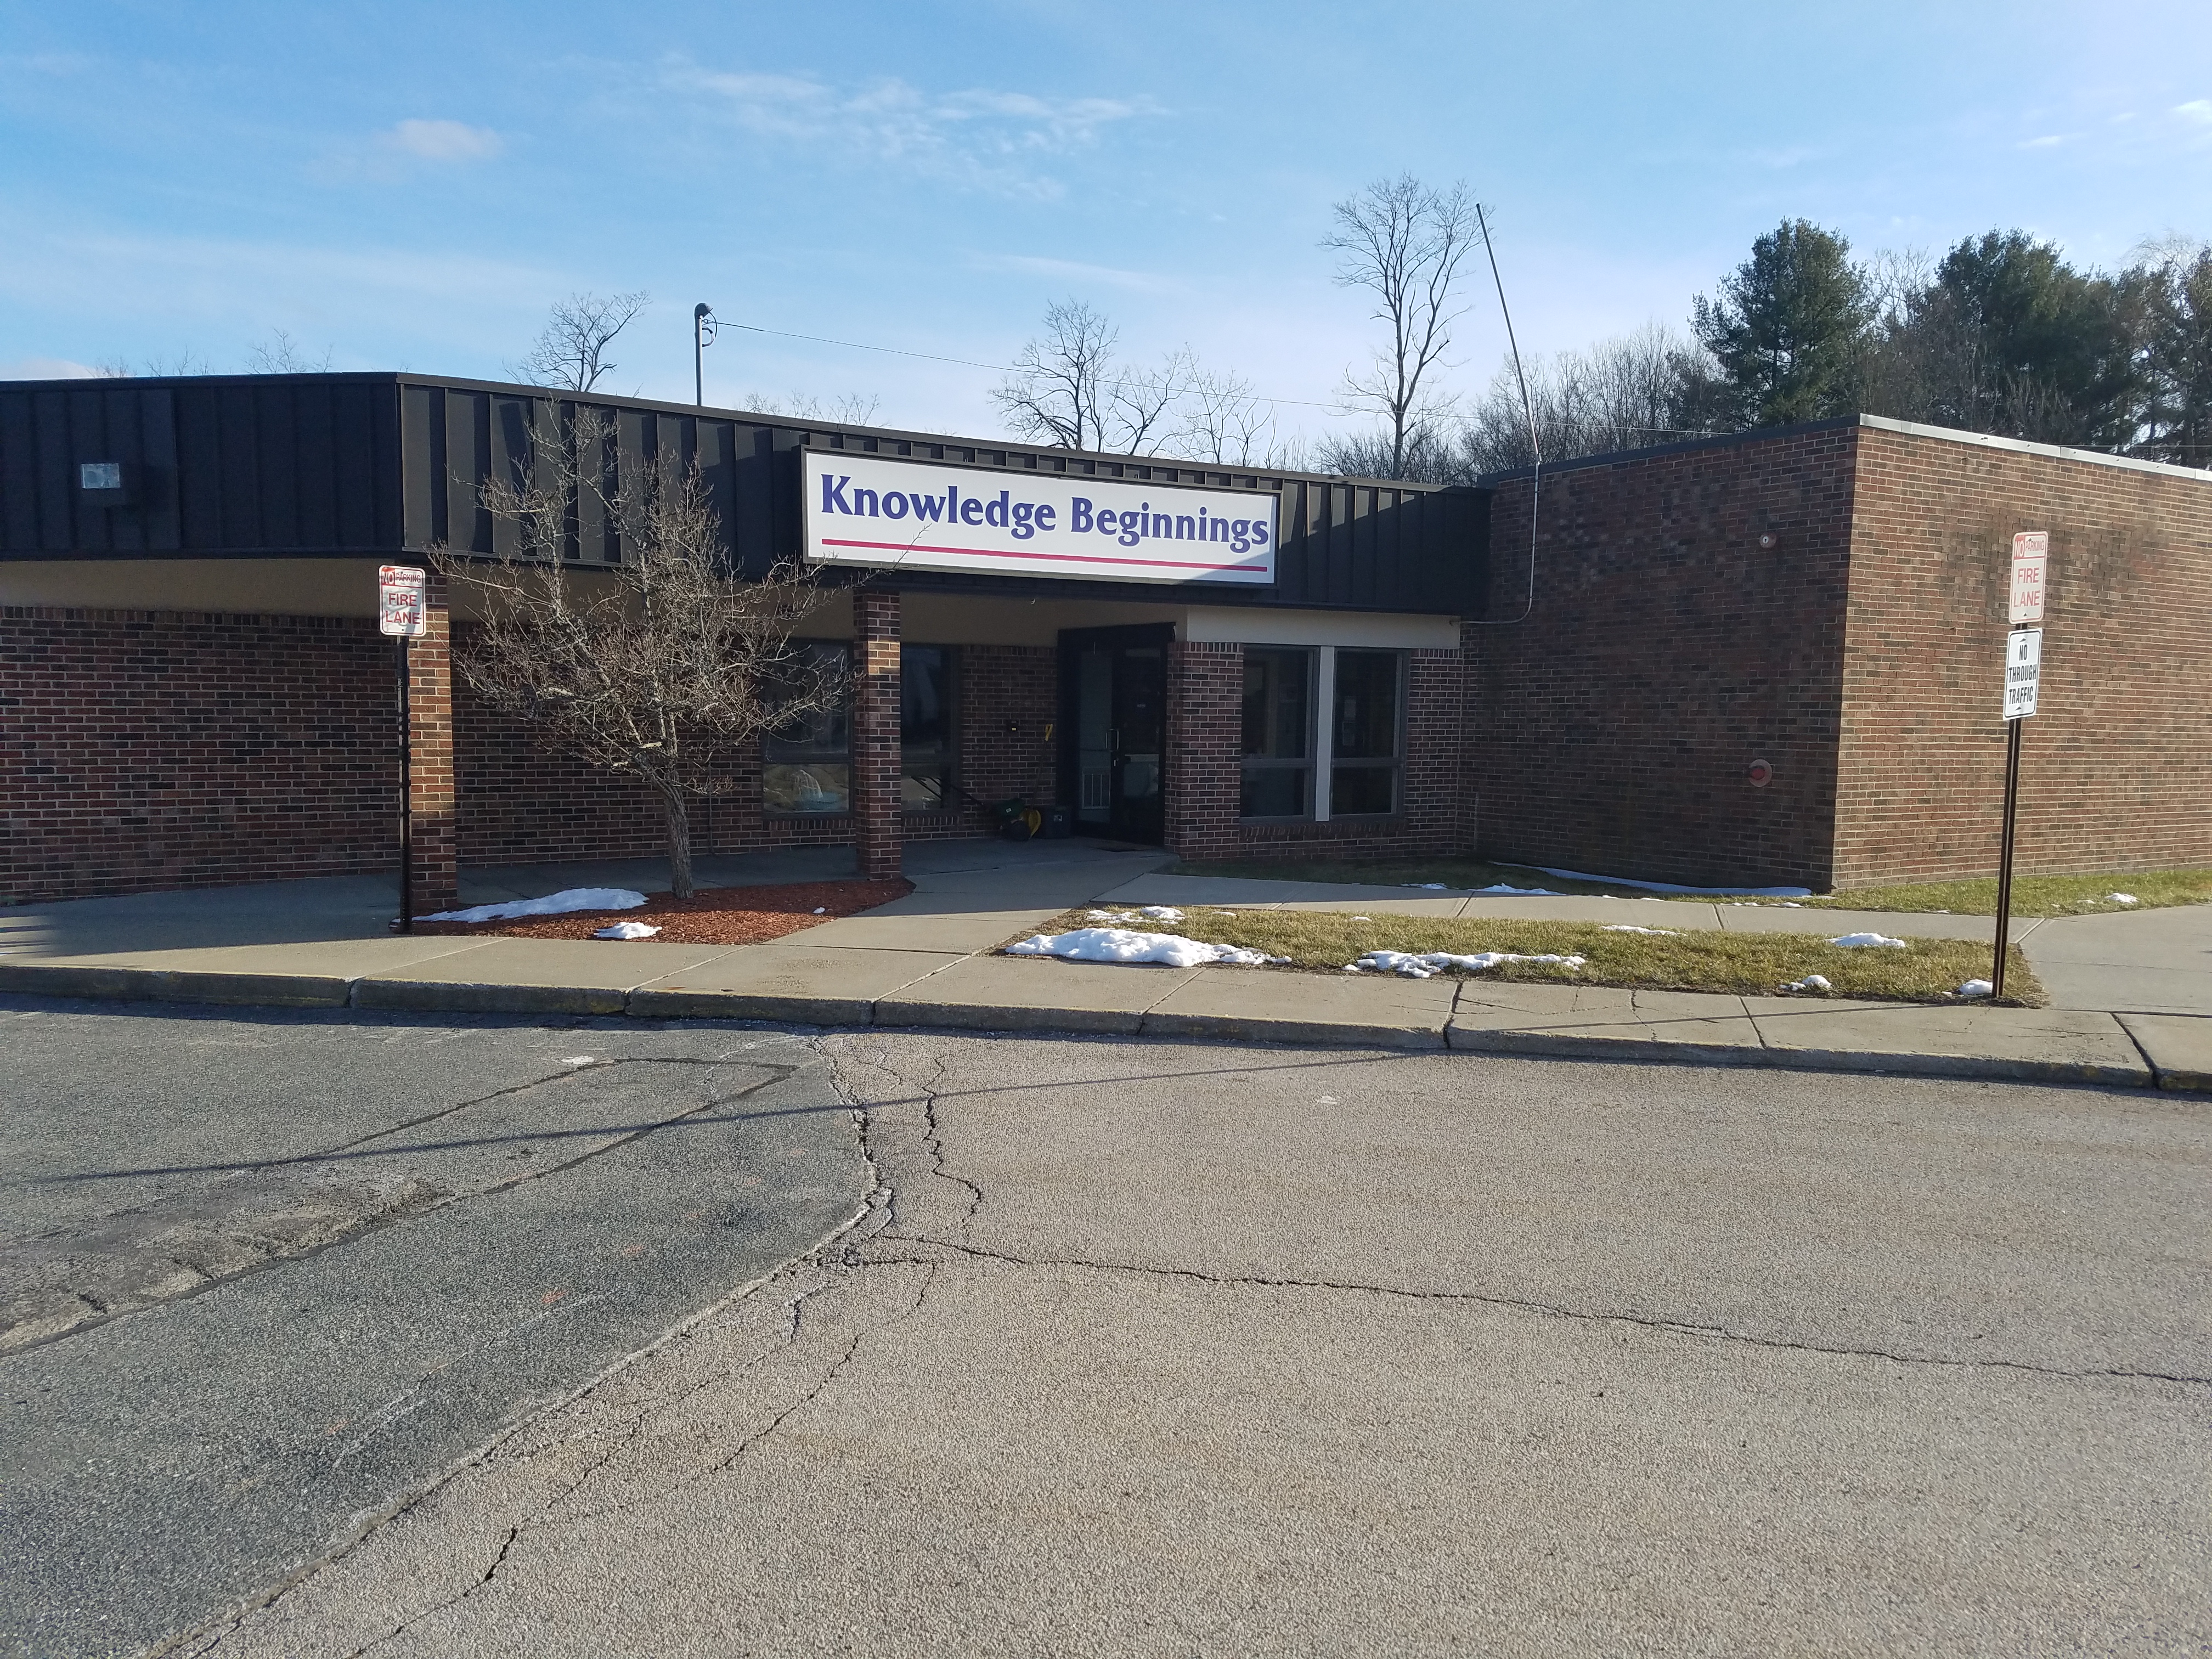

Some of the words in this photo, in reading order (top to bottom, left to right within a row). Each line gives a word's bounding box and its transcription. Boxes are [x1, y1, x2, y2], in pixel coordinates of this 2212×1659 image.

[820, 473, 1056, 540] Knowledge
[1070, 496, 1269, 554] Beginnings
[2015, 540, 2024, 557] NO
[2025, 540, 2044, 552] PARKING
[382, 571, 394, 585] NO
[396, 573, 421, 583] PARKING
[2017, 567, 2040, 584] FIRE
[388, 592, 417, 607] FIRE
[2013, 590, 2041, 607] LANE
[385, 610, 420, 624] LANE
[2018, 644, 2028, 661] NO
[2008, 664, 2037, 683] THROUGH
[2008, 686, 2034, 705] TRAFFIC
